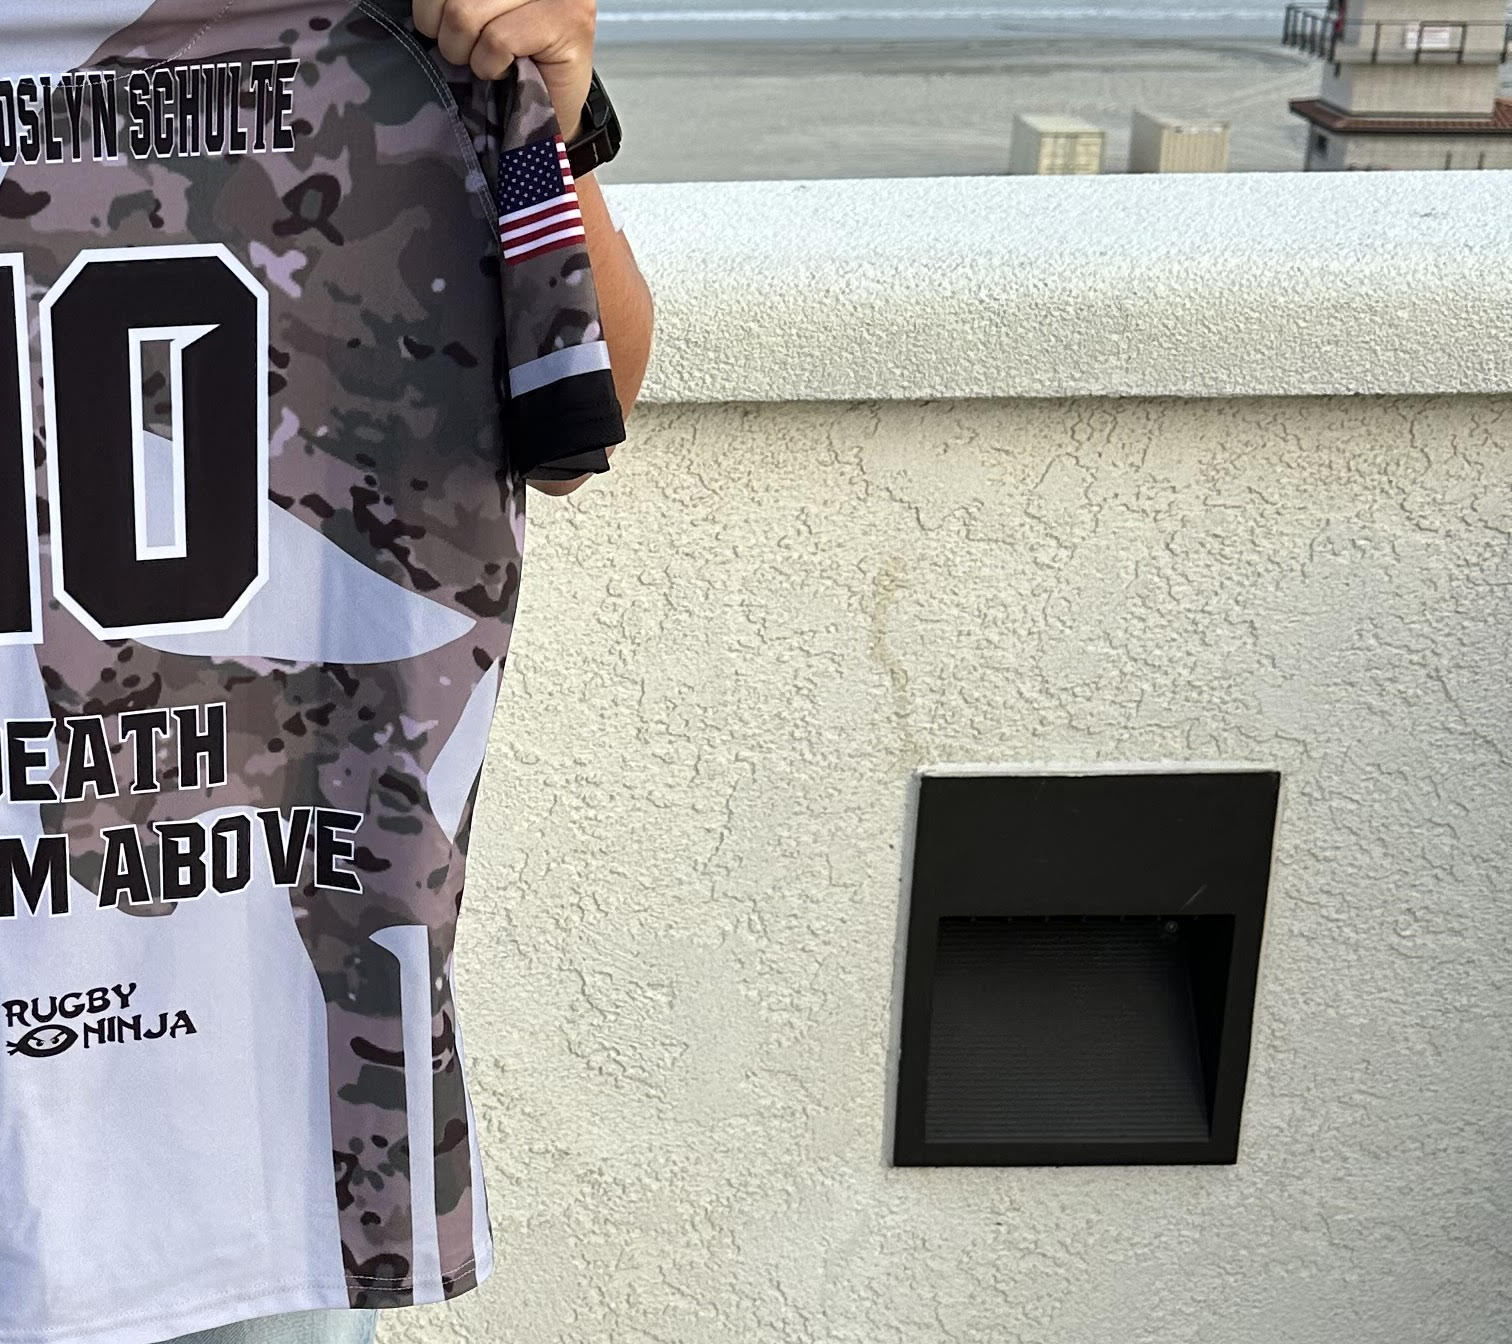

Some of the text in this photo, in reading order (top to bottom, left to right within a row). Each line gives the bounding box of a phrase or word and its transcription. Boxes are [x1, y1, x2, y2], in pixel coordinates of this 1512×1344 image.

[124, 58, 301, 159] SCHULTE
[96, 806, 364, 911] ABOVE
[1, 982, 138, 1028] RUGBY
[82, 1009, 197, 1049] NINJA
